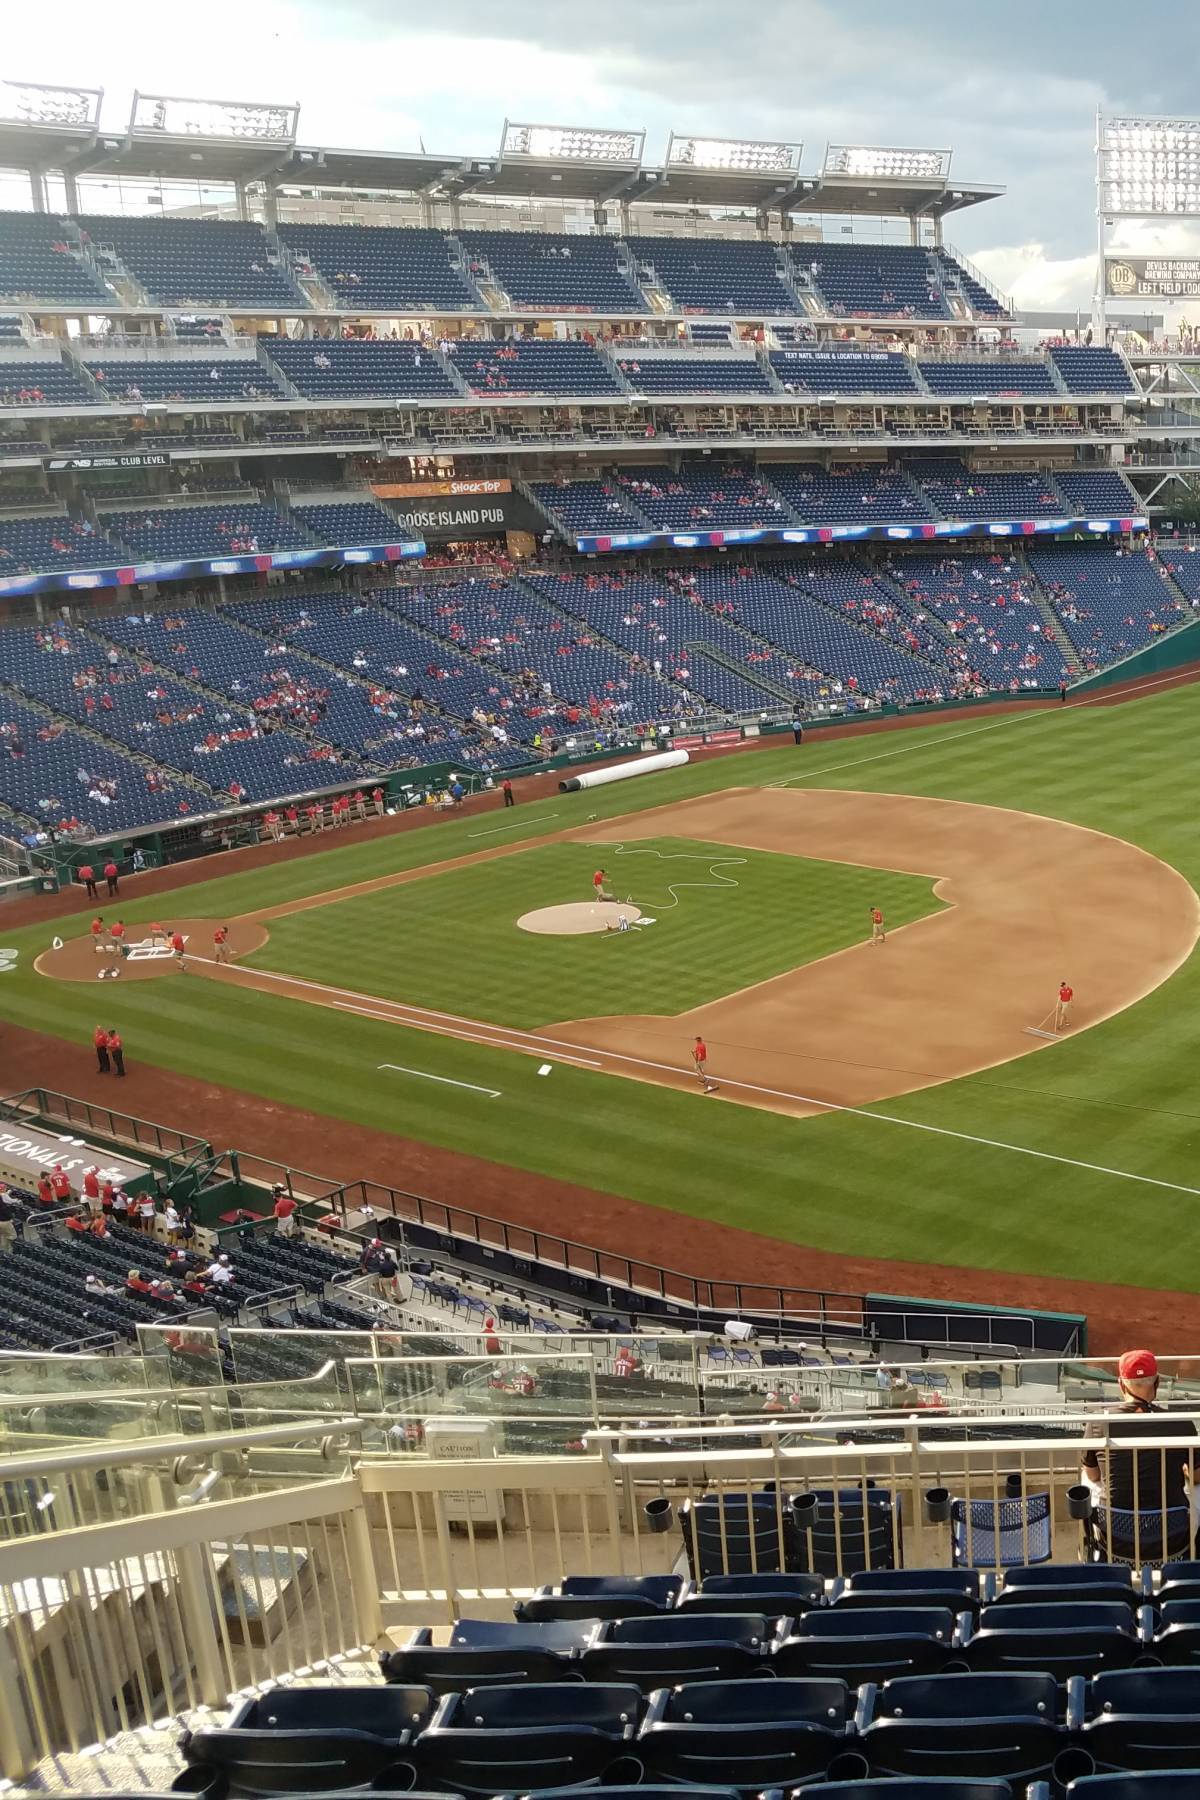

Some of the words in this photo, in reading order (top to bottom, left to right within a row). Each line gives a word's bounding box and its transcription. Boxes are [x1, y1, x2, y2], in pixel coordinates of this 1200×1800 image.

[1168, 262, 1200, 270] BACKBONE
[1145, 270, 1172, 279] BREWING
[1173, 271, 1200, 280] COMPANY
[1138, 282, 1157, 294] LEFT
[1160, 282, 1181, 294] FIELD
[121, 457, 140, 465] CLUB
[142, 456, 166, 465] LEVEL
[398, 512, 436, 528] GOOSE
[439, 510, 478, 525] ISLAND
[481, 508, 504, 522] PUB
[618, 1365, 626, 1376] 11
